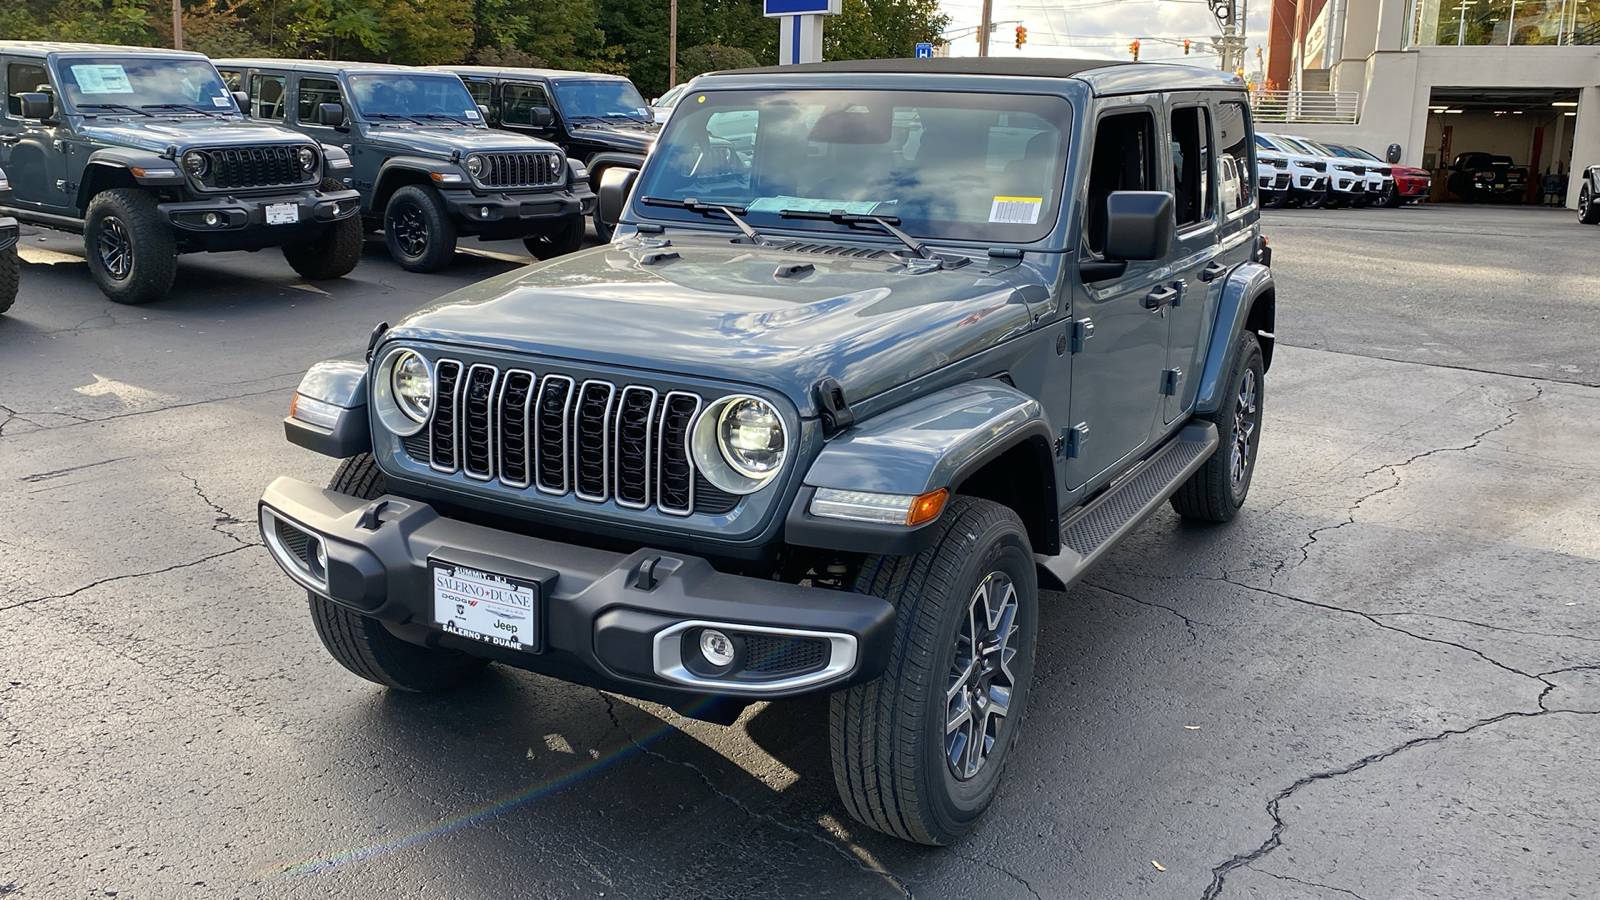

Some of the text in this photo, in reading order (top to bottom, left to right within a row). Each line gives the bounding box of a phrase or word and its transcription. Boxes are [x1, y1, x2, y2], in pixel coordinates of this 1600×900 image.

[494, 575, 507, 583] NJ
[437, 577, 531, 608] SALERNO DUANE
[441, 593, 471, 605] DODGE
[493, 619, 518, 634] Jeep
[442, 624, 523, 650] SALERNO DUANE
